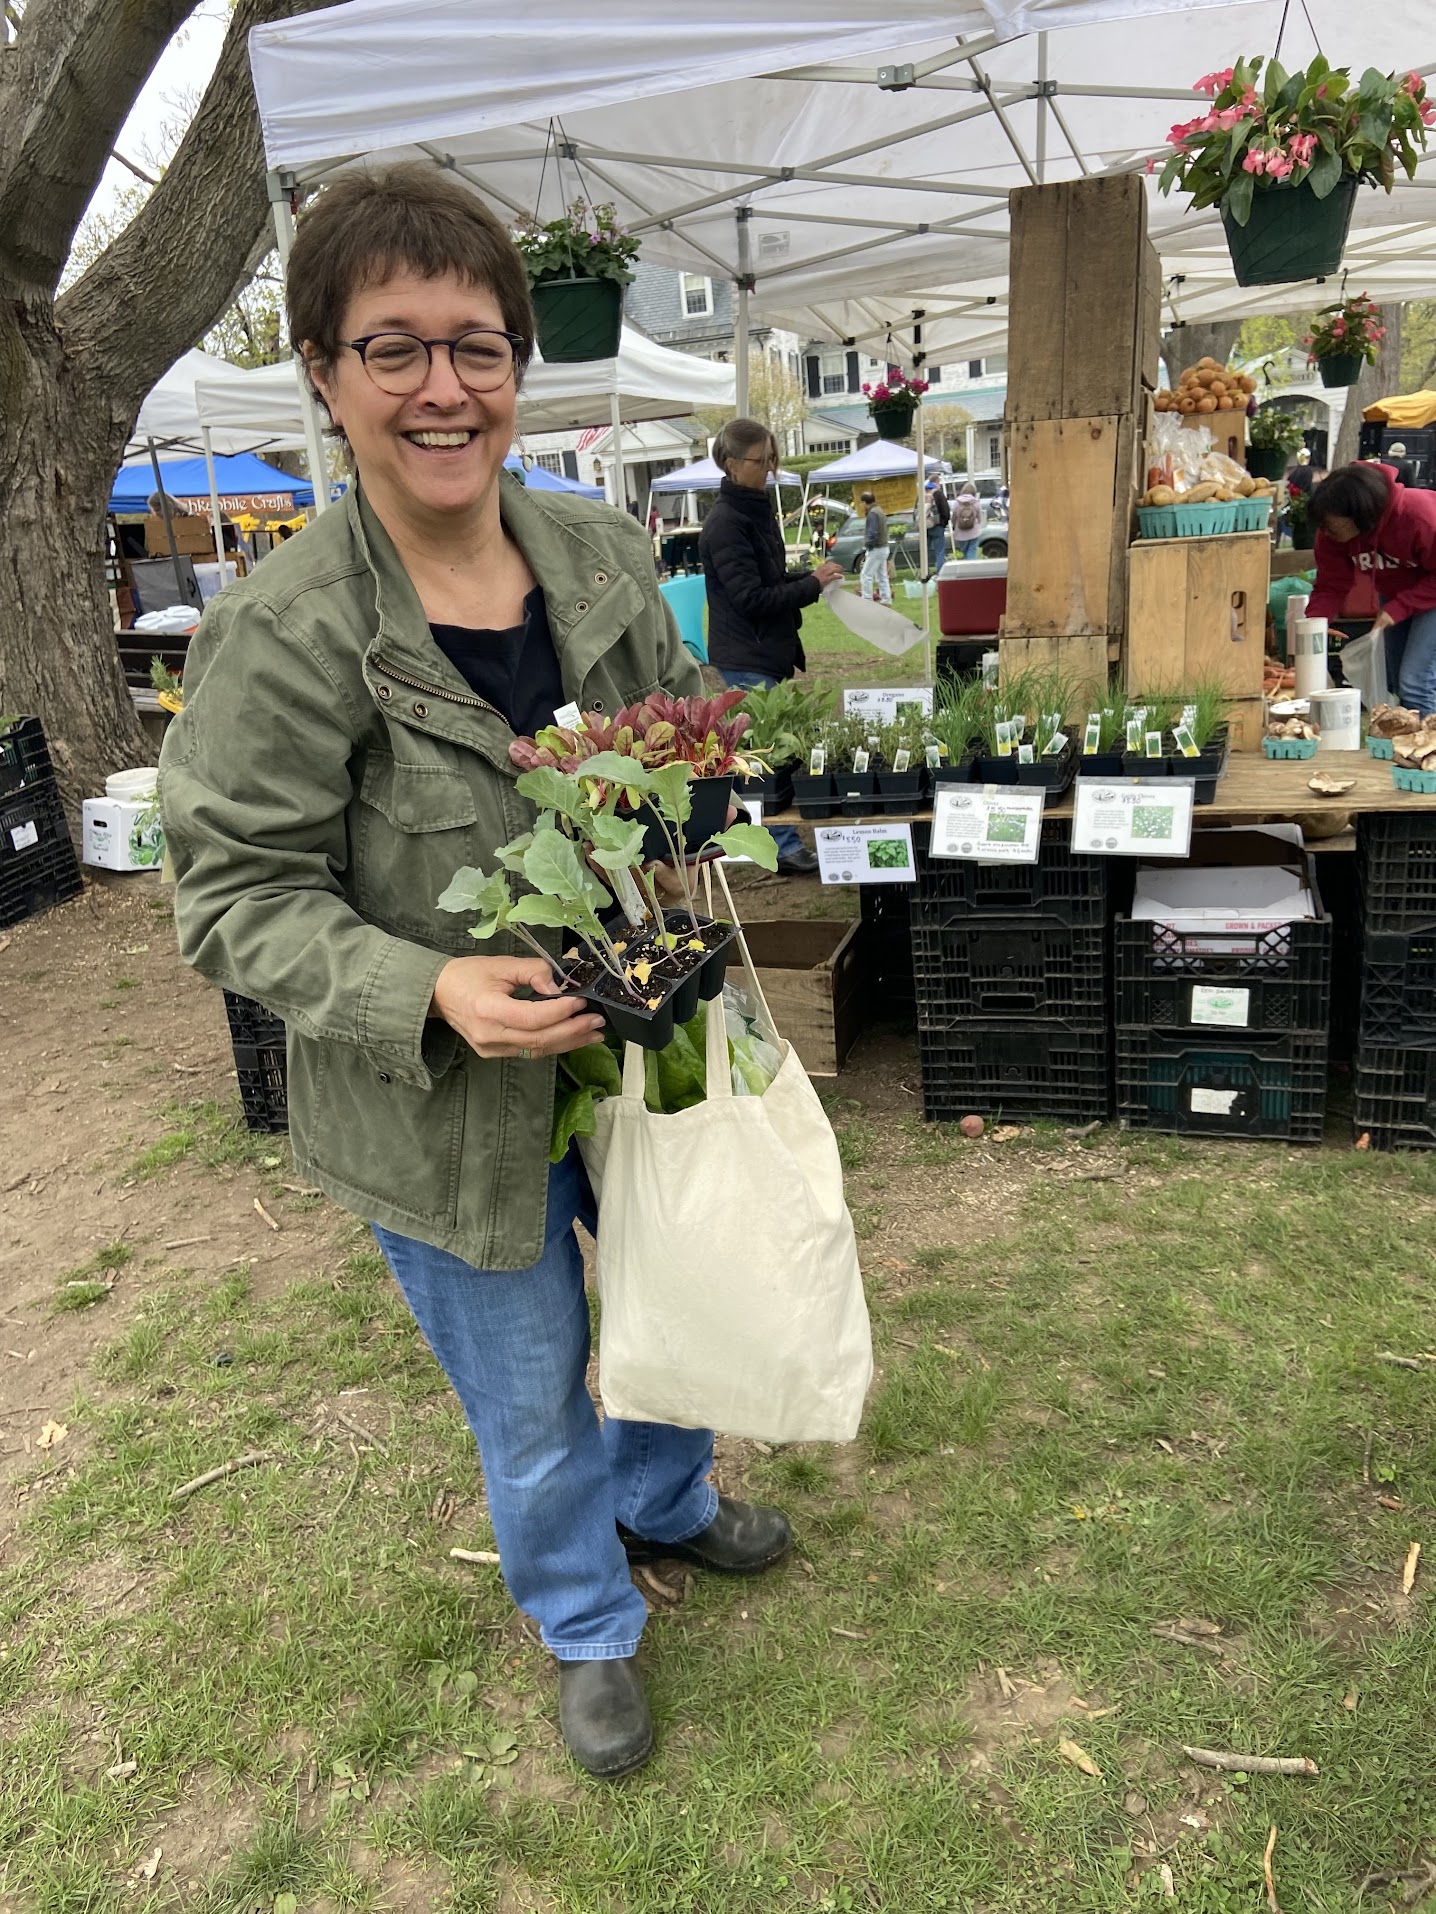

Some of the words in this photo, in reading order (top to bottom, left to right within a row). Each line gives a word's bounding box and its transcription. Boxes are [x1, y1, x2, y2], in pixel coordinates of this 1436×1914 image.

[251, 494, 292, 511] Crafts
[1225, 922, 1249, 930] GROWN
[1250, 922, 1256, 930] &
